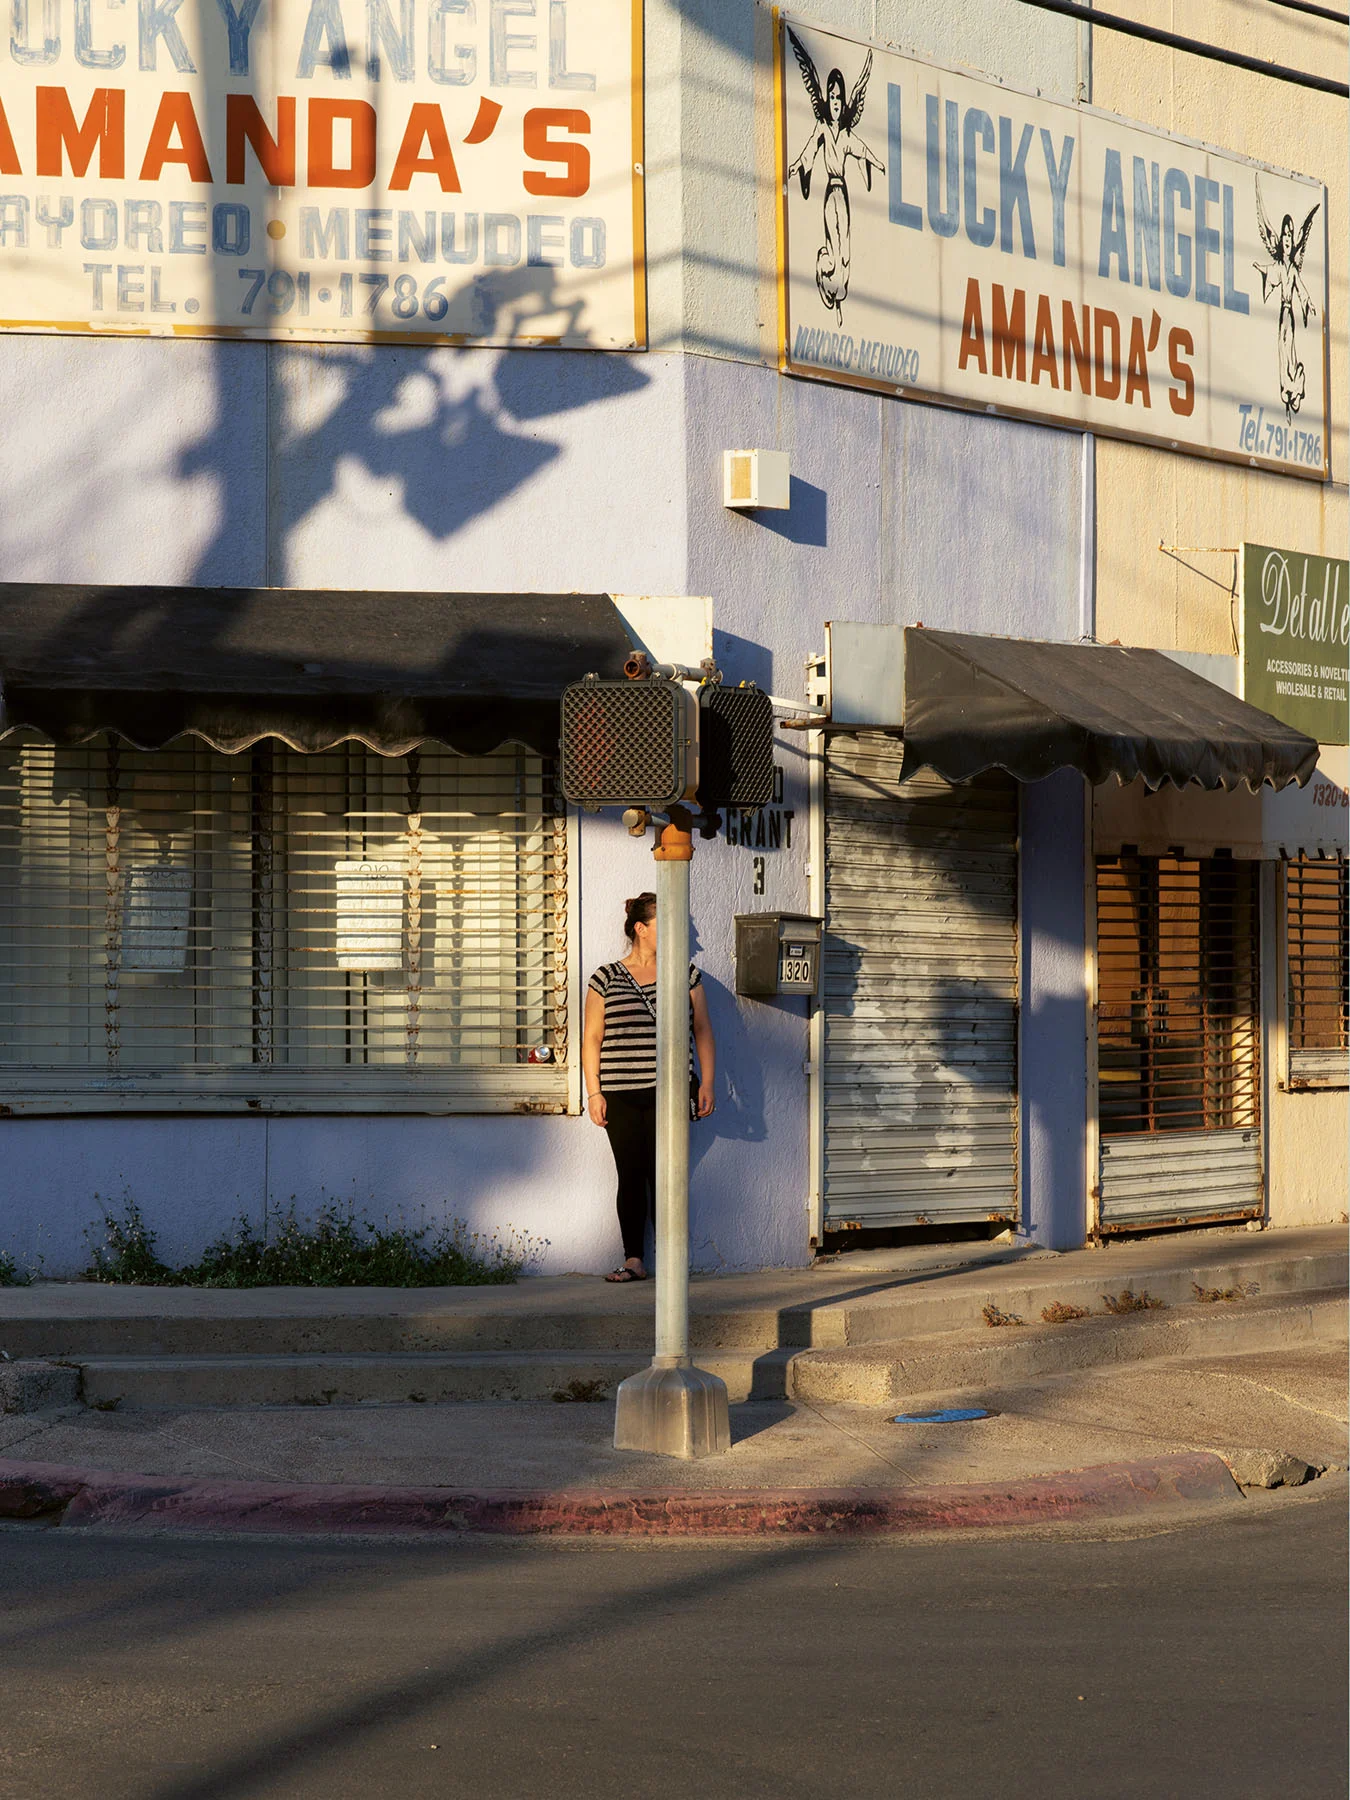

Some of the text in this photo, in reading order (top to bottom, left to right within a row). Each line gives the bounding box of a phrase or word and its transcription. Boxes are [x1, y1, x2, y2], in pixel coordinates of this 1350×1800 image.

[296, 0, 597, 92] ANGEL
[887, 82, 1250, 316] LUCKY ANGEL
[300, 206, 607, 270] MENUDEO
[83, 263, 201, 314] TEL.
[958, 277, 1195, 417] AMANDA'S
[1266, 658, 1312, 677] ACCESSORIES
[1313, 665, 1319, 678] &
[1276, 680, 1347, 701] WHOLESALE & RETAIL
[726, 808, 795, 849] GRANT
[754, 857, 765, 895] 3
[780, 961, 809, 981] 1320
